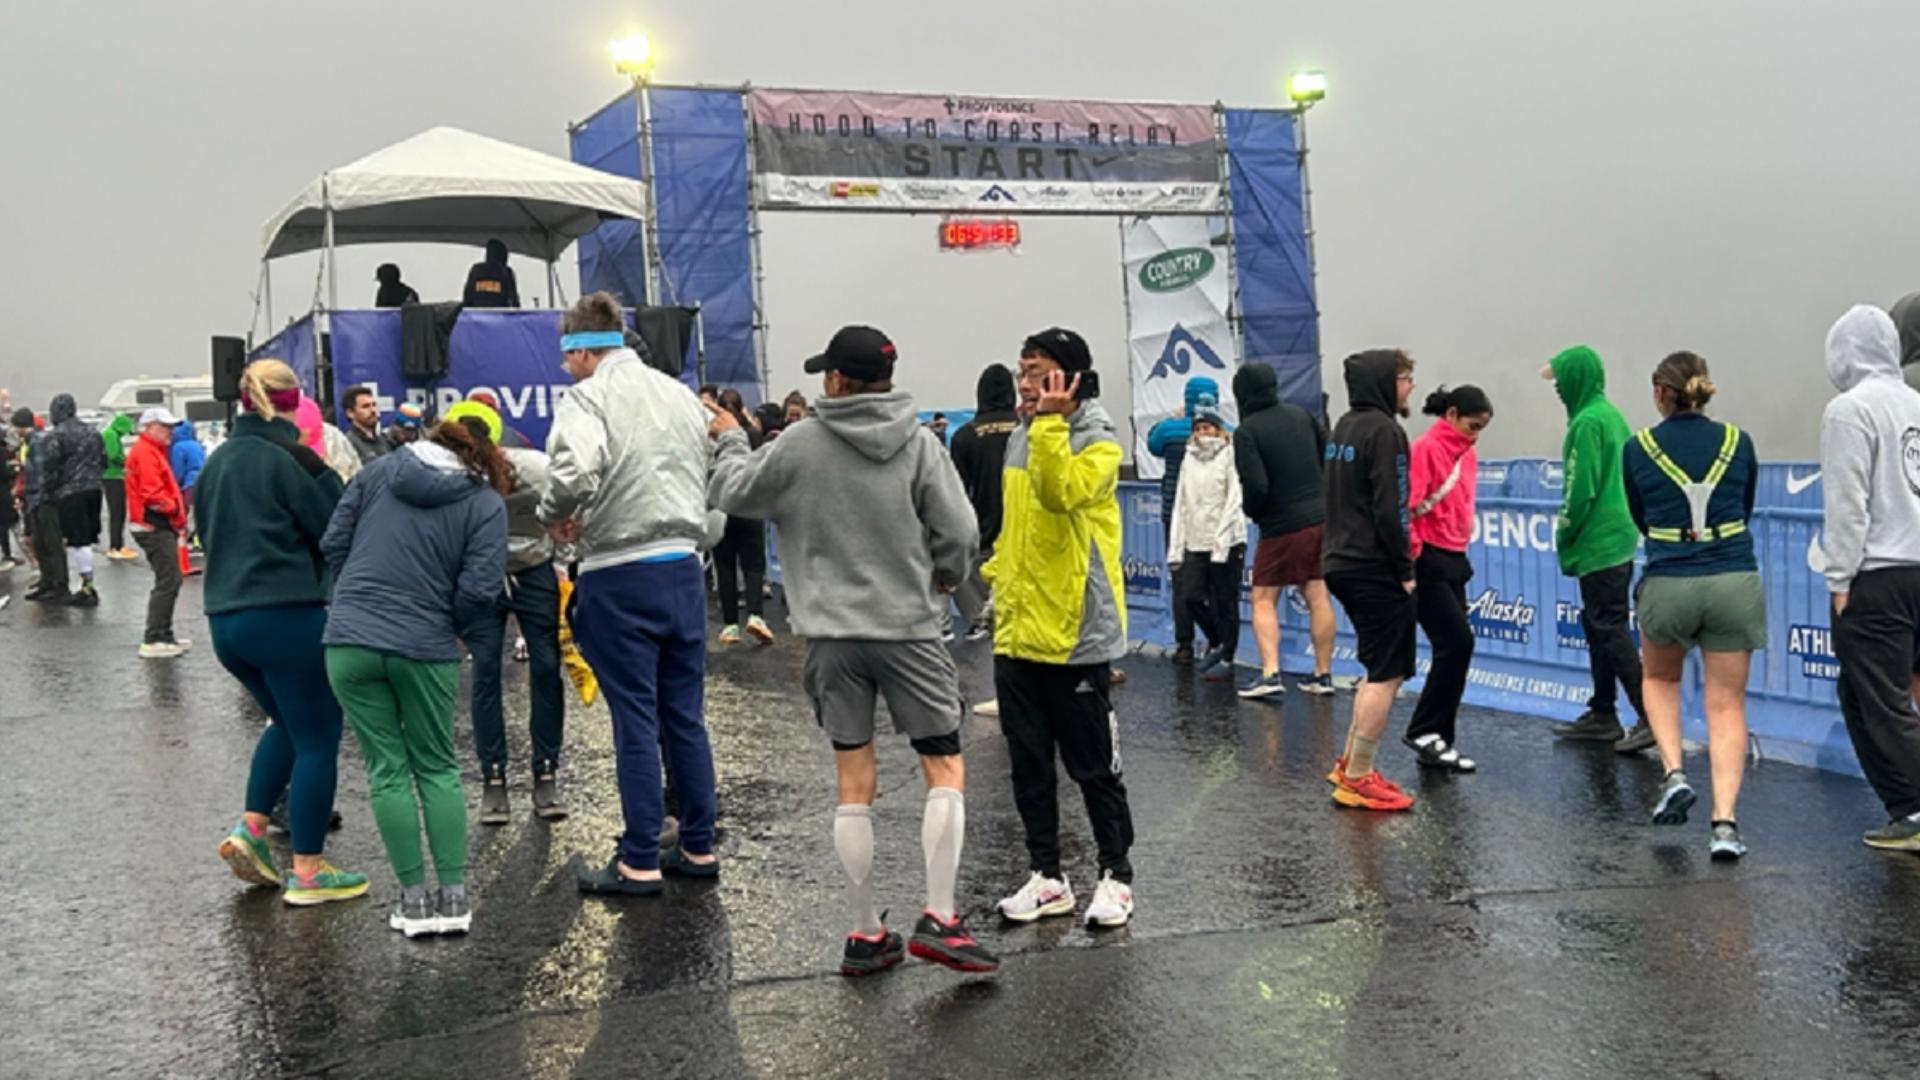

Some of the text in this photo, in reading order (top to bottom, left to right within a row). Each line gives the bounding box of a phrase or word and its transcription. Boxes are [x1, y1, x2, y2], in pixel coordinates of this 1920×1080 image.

[958, 99, 1034, 114] PROVIDENCE
[788, 112, 1178, 147] HOOD TO COAST RELAY
[903, 143, 1080, 180] START
[1147, 252, 1203, 283] COUNTRY
[1467, 588, 1534, 627] Alaska
[1556, 603, 1582, 624] Fir
[1789, 627, 1835, 657] ATHL
